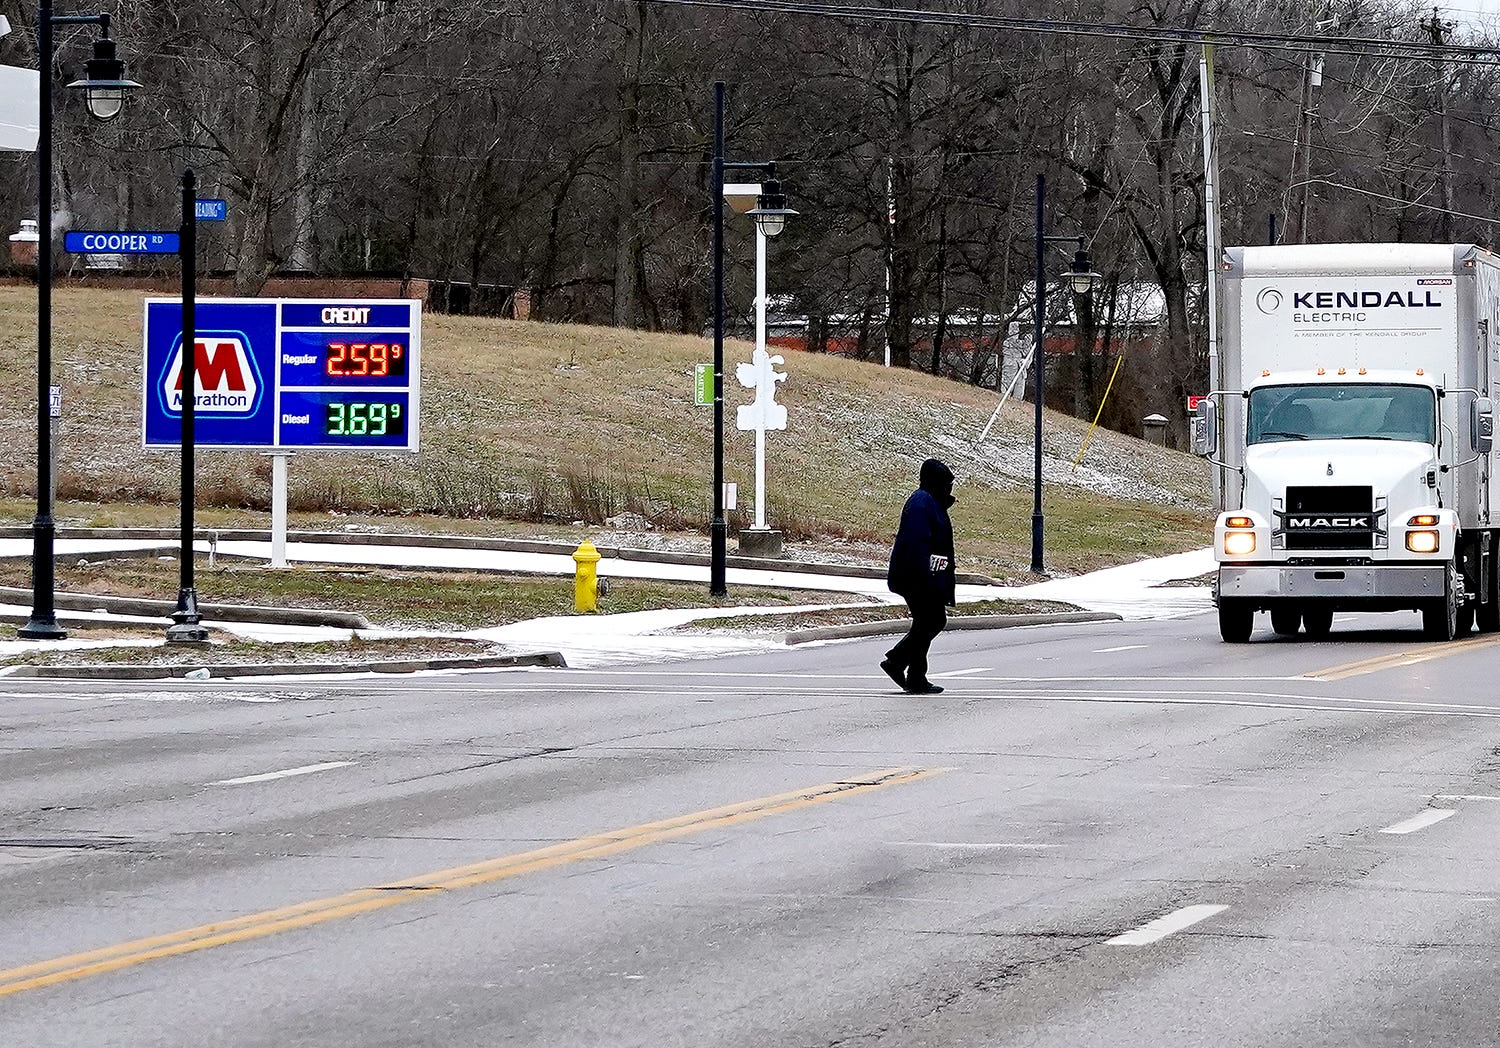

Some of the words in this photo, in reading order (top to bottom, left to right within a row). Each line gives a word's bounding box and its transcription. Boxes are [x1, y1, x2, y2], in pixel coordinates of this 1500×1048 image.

[83, 234, 148, 251] COOPER
[151, 235, 164, 244] RD
[1293, 290, 1442, 309] KENDALL
[321, 307, 371, 324] CREDIT
[1293, 312, 1367, 323] ELECTRIC
[174, 343, 247, 391] M
[282, 354, 318, 365] Regular
[326, 343, 388, 376] 2.59
[282, 414, 310, 424] Diesel
[327, 403, 387, 435] 3.69
[1289, 517, 1368, 528] MACK
